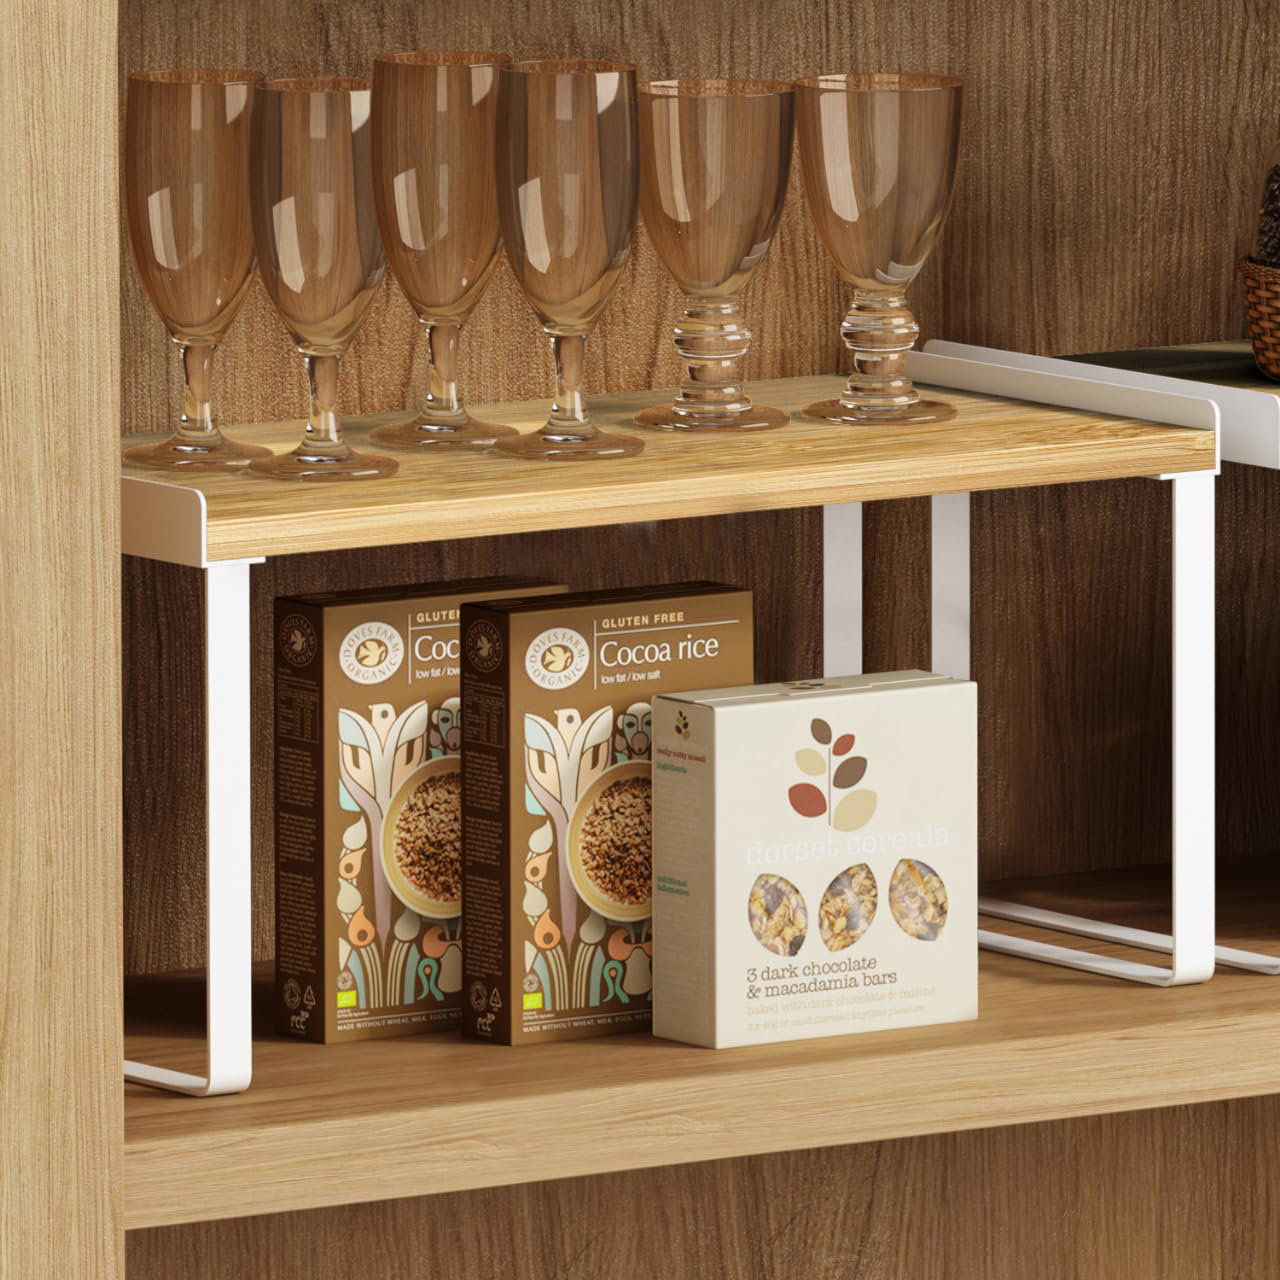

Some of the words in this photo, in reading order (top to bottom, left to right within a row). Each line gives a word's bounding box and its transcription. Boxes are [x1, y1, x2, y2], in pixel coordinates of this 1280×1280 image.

[601, 615, 649, 629] GLUTEN
[654, 612, 684, 623] FREE
[529, 631, 560, 663] DOVES
[560, 631, 585, 659] FARM
[600, 640, 671, 667] Cocoa
[678, 633, 719, 660] rice
[346, 660, 397, 681] ORGANIC
[533, 664, 583, 686] ORGANIC
[601, 673, 615, 684] low
[616, 671, 626, 682] fat
[632, 671, 645, 681] low
[746, 832, 839, 866] dorset
[847, 823, 949, 856] cereals
[746, 969, 758, 982] 3
[761, 964, 799, 982] dark
[803, 957, 877, 976] chocolate
[746, 985, 761, 999] &
[765, 975, 858, 998] macadamia
[863, 972, 897, 987] bars
